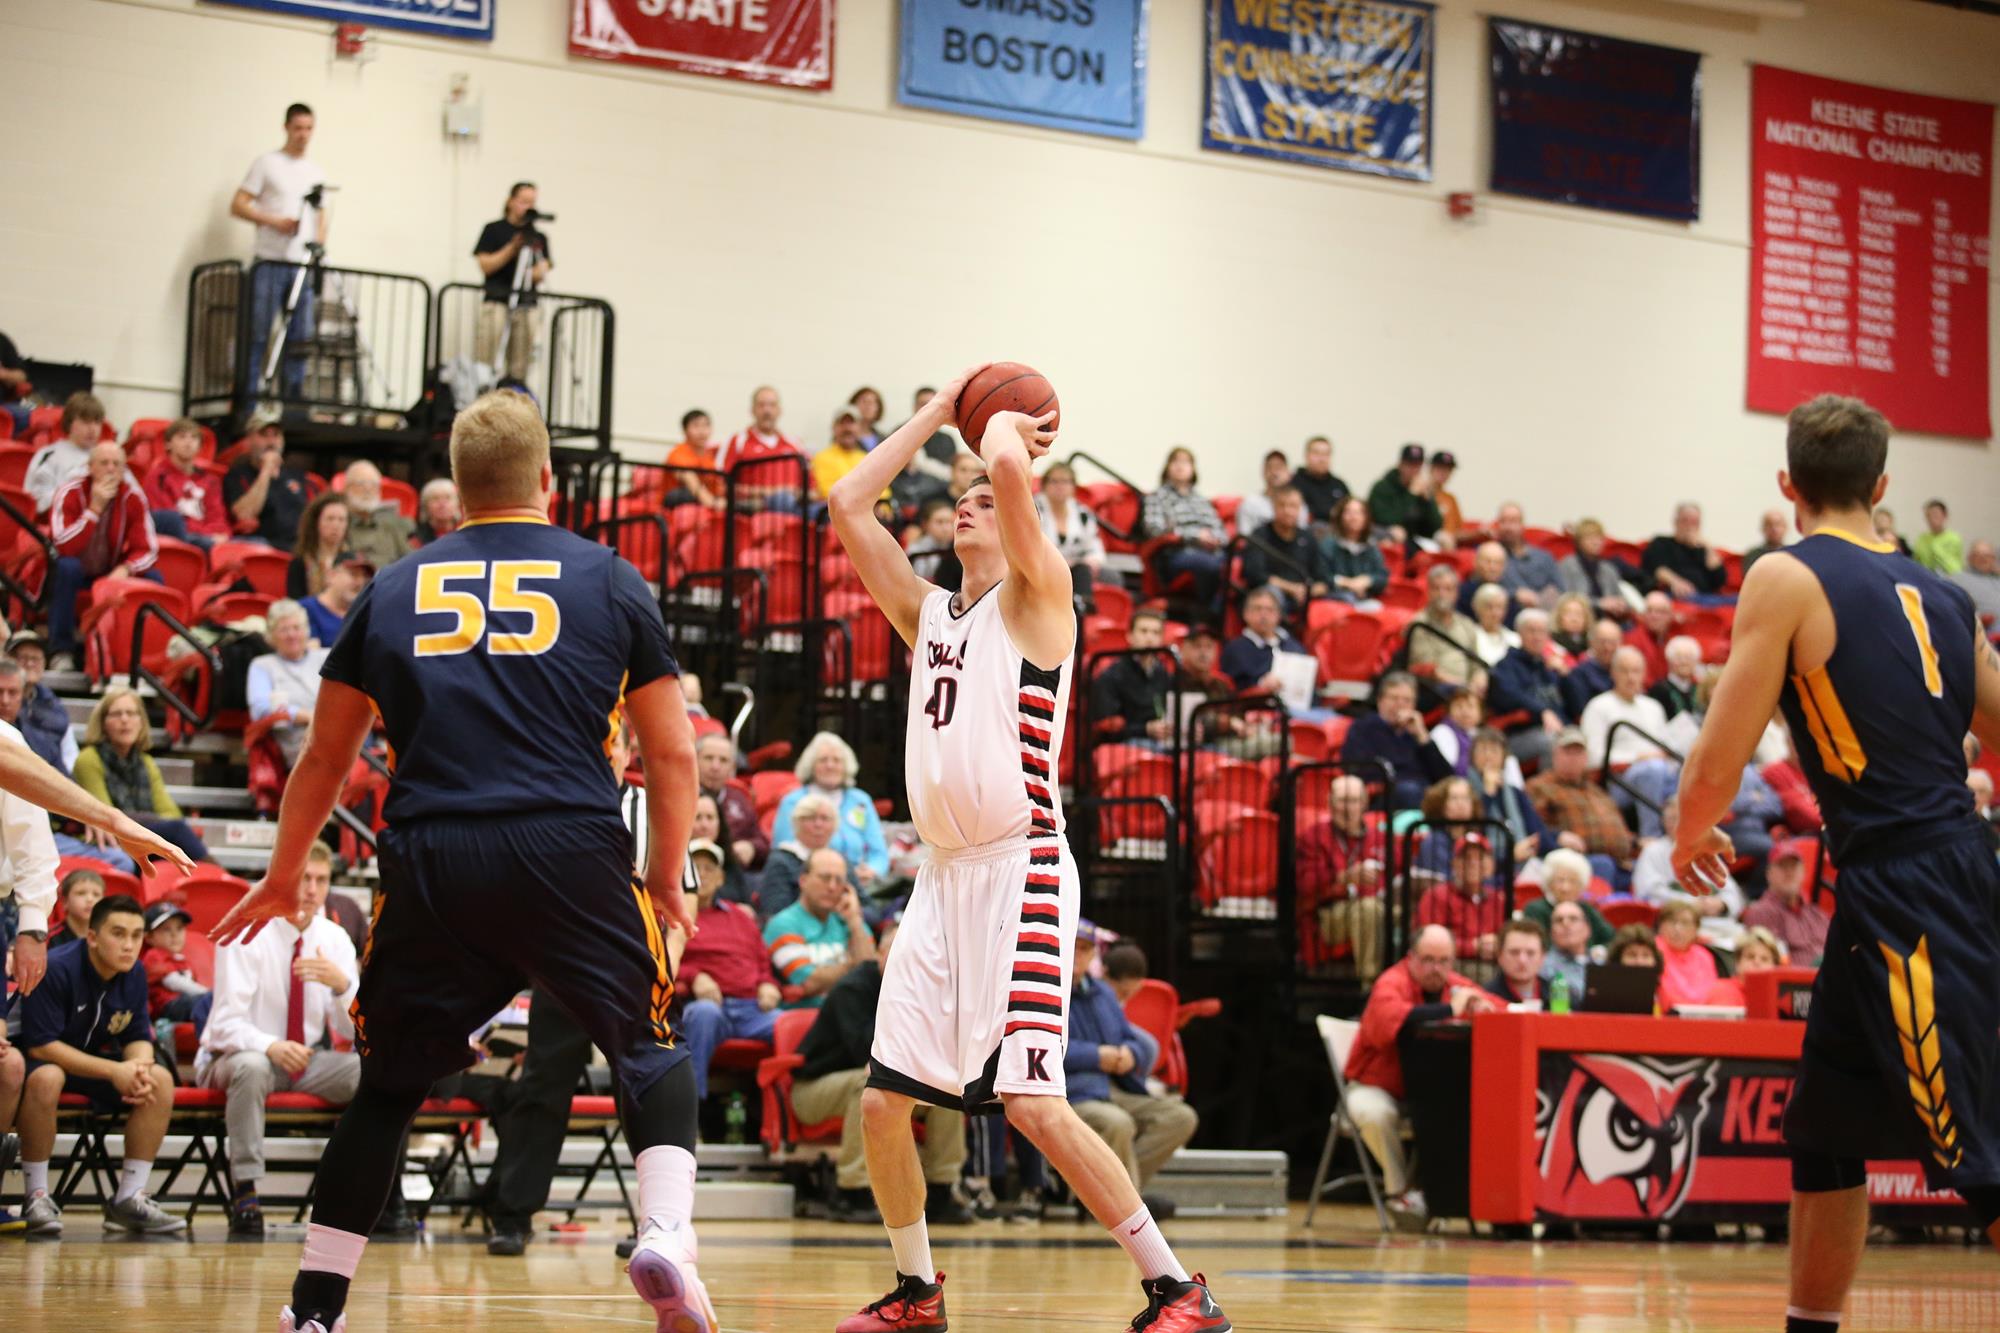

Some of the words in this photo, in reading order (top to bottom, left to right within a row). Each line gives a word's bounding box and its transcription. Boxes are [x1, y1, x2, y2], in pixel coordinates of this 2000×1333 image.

[958, 0, 1095, 26] ASS
[1233, 0, 1411, 52] WESTERN
[943, 27, 1104, 84] BOSTON
[1262, 101, 1377, 151] STATE
[1811, 97, 1876, 132] KEENE
[1883, 111, 1940, 142] STATE
[1765, 119, 1864, 159] NATIONAL
[1867, 137, 1982, 177] CHAMPIONS
[413, 559, 562, 657] 55
[1894, 582, 1943, 699] 1
[1026, 1047, 1051, 1082] K
[1720, 1076, 1796, 1143] KE
